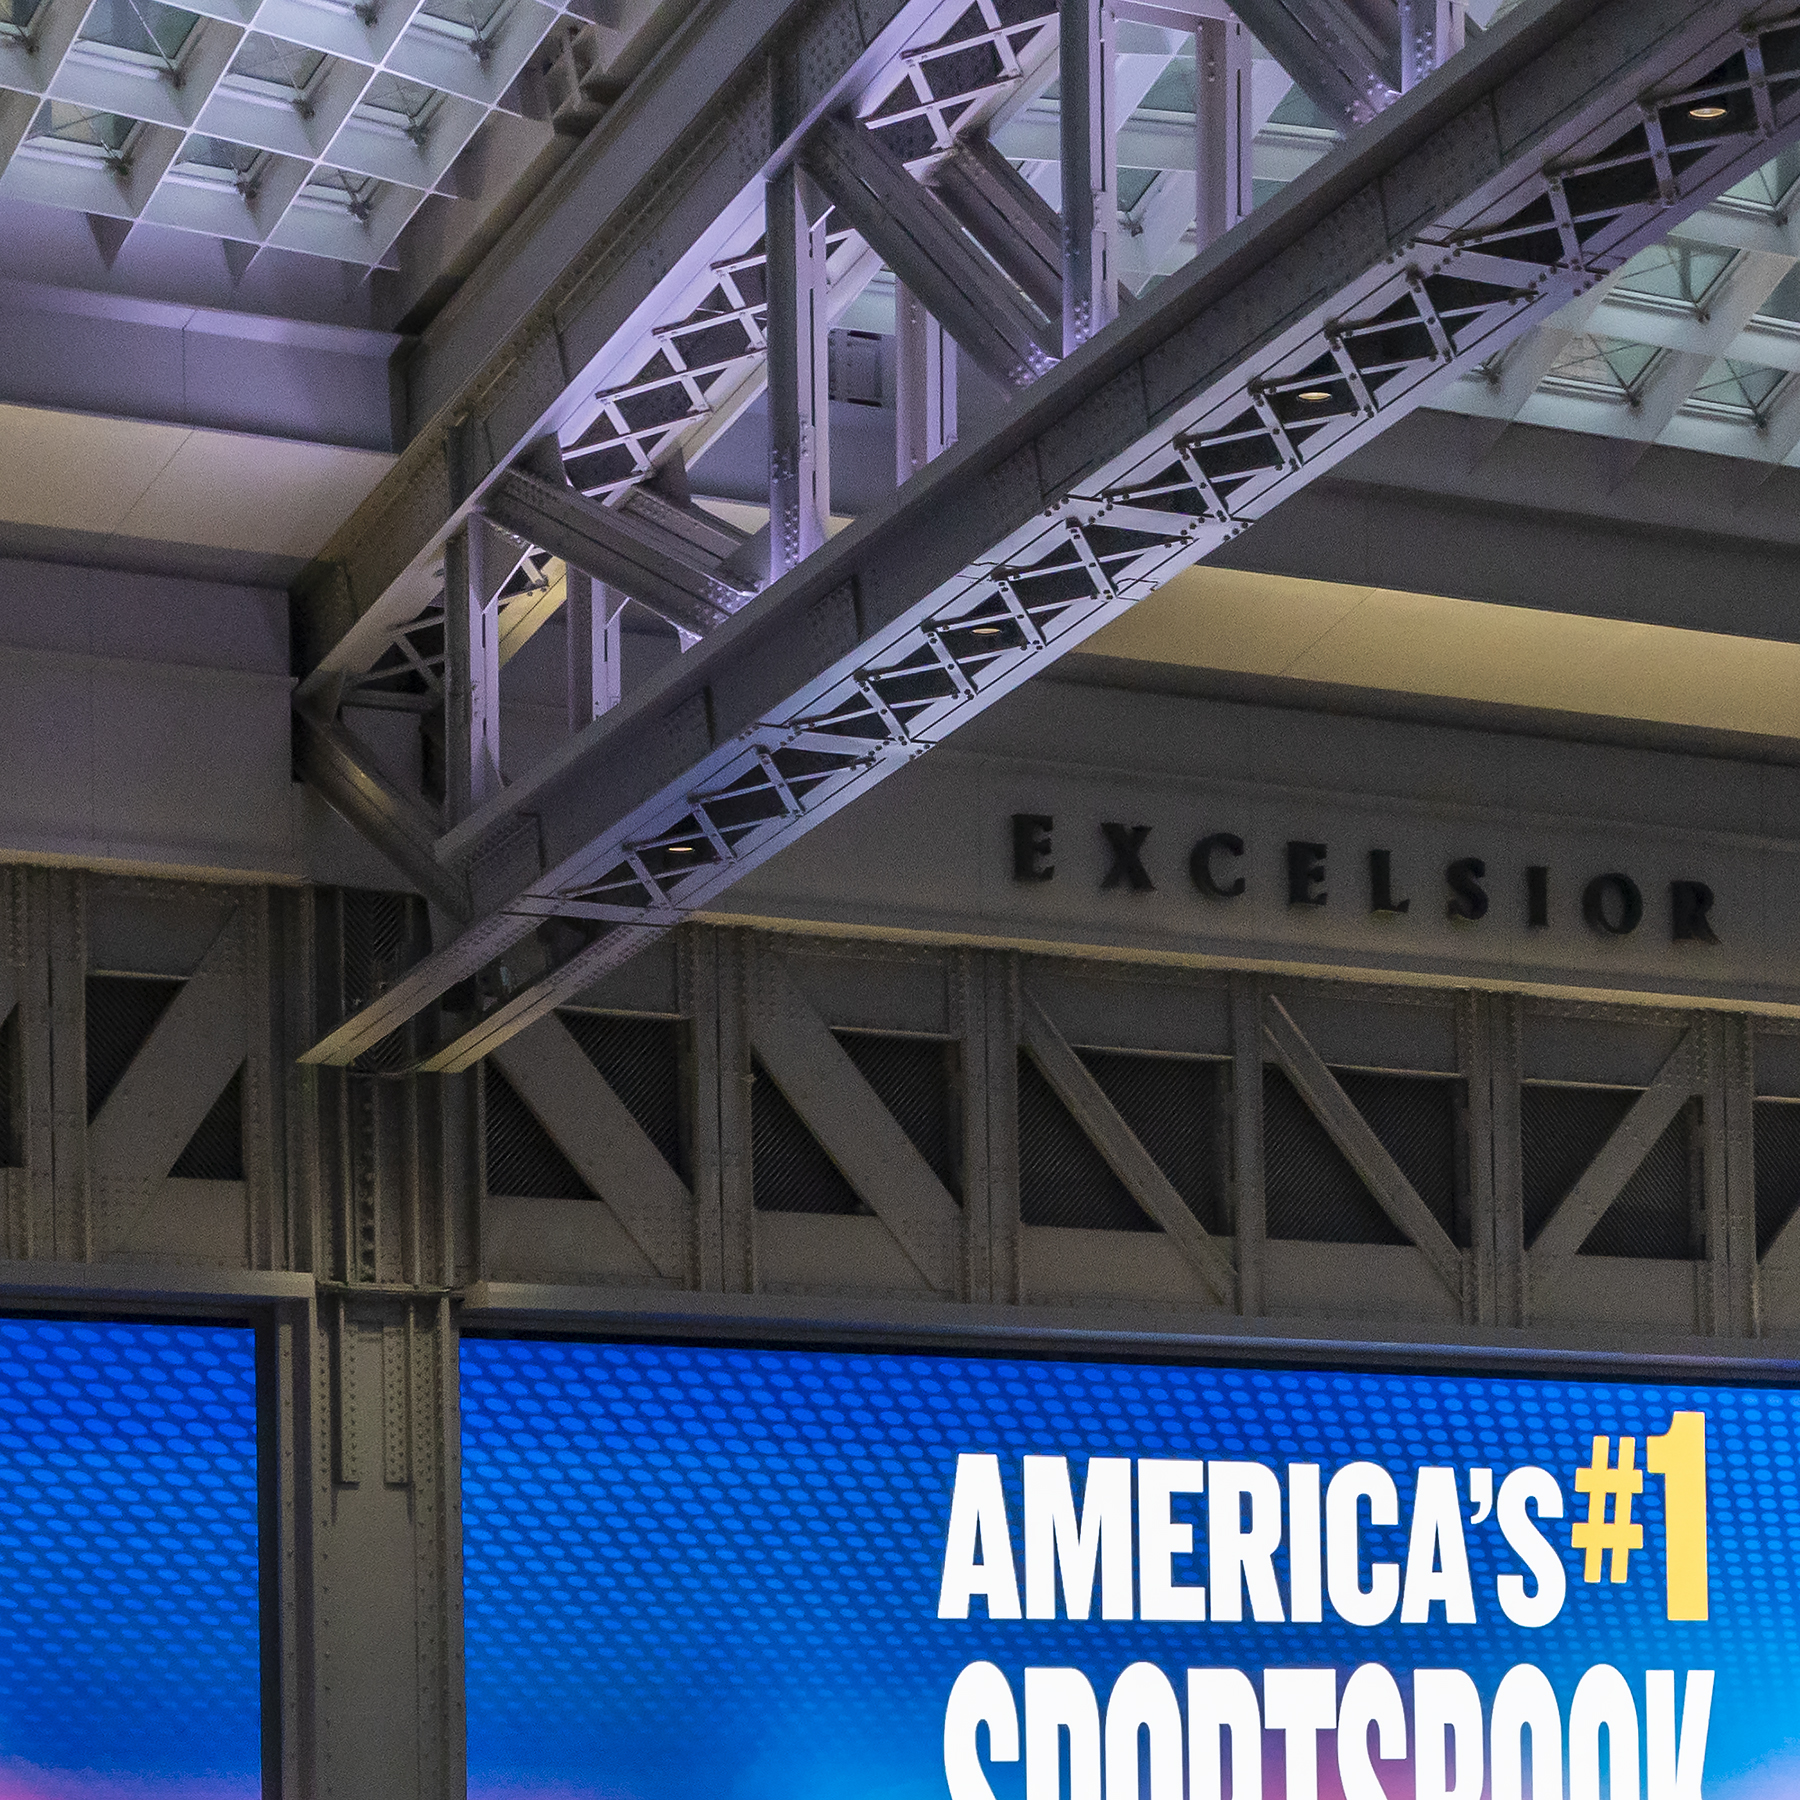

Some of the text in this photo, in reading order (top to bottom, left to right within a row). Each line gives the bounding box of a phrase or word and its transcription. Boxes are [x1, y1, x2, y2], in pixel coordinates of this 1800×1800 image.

[1011, 813, 1722, 944] EXCELSIOR
[937, 1411, 1708, 1628] AMERICA'S #1
